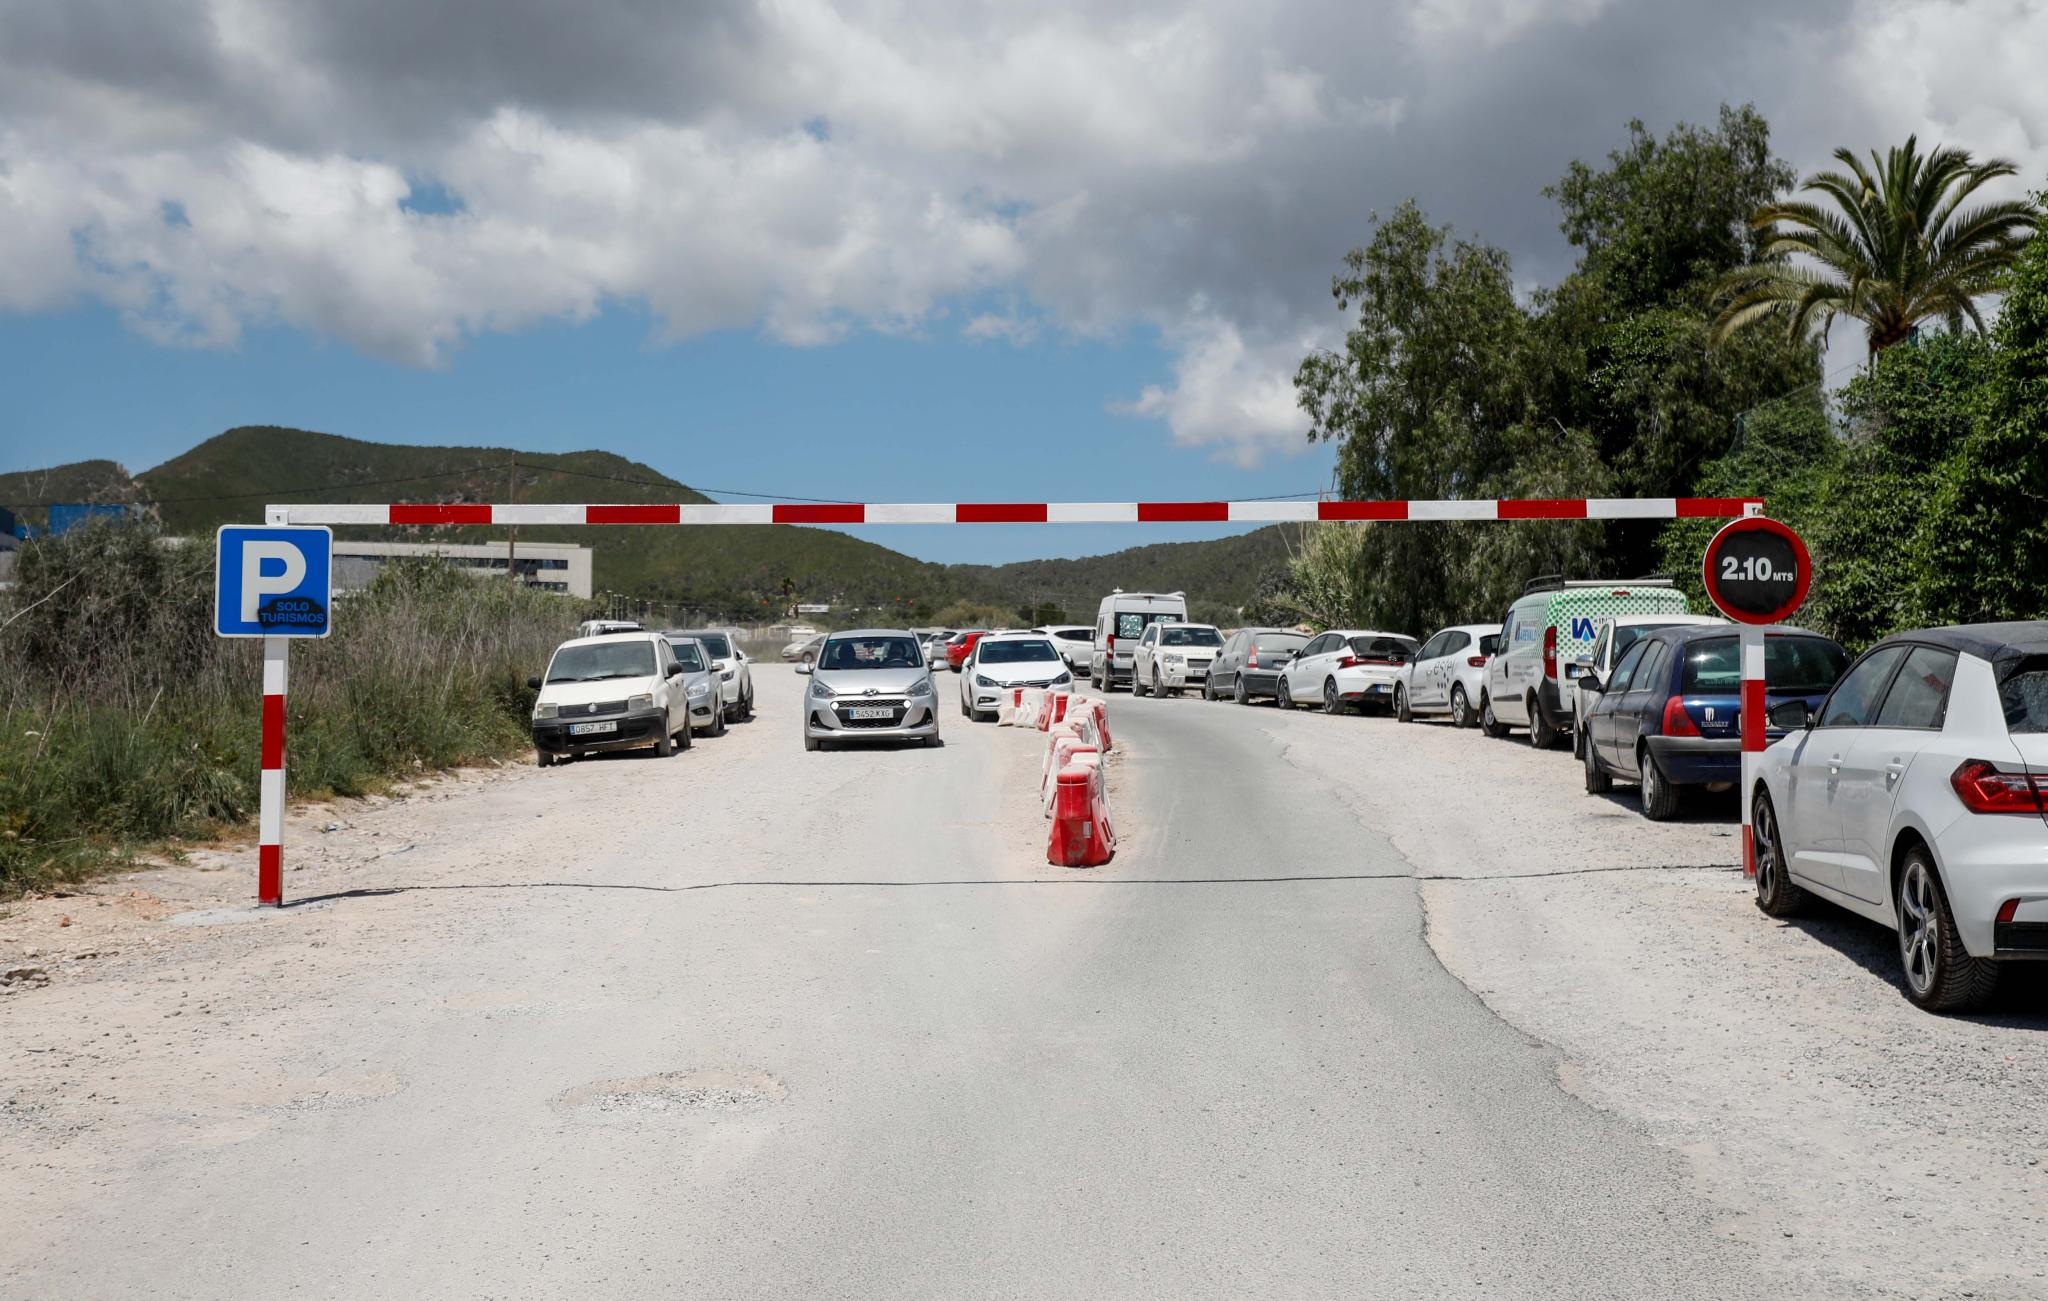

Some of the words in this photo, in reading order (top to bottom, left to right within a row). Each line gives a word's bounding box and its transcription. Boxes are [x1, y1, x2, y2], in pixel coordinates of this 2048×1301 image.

[1721, 556, 1772, 581] 2.10
[1773, 572, 1794, 581] MTS
[241, 540, 307, 622] P
[276, 602, 310, 612] SOLO
[261, 612, 325, 623] TURISMOS
[855, 710, 874, 718] 5452
[575, 724, 595, 734] 0857
